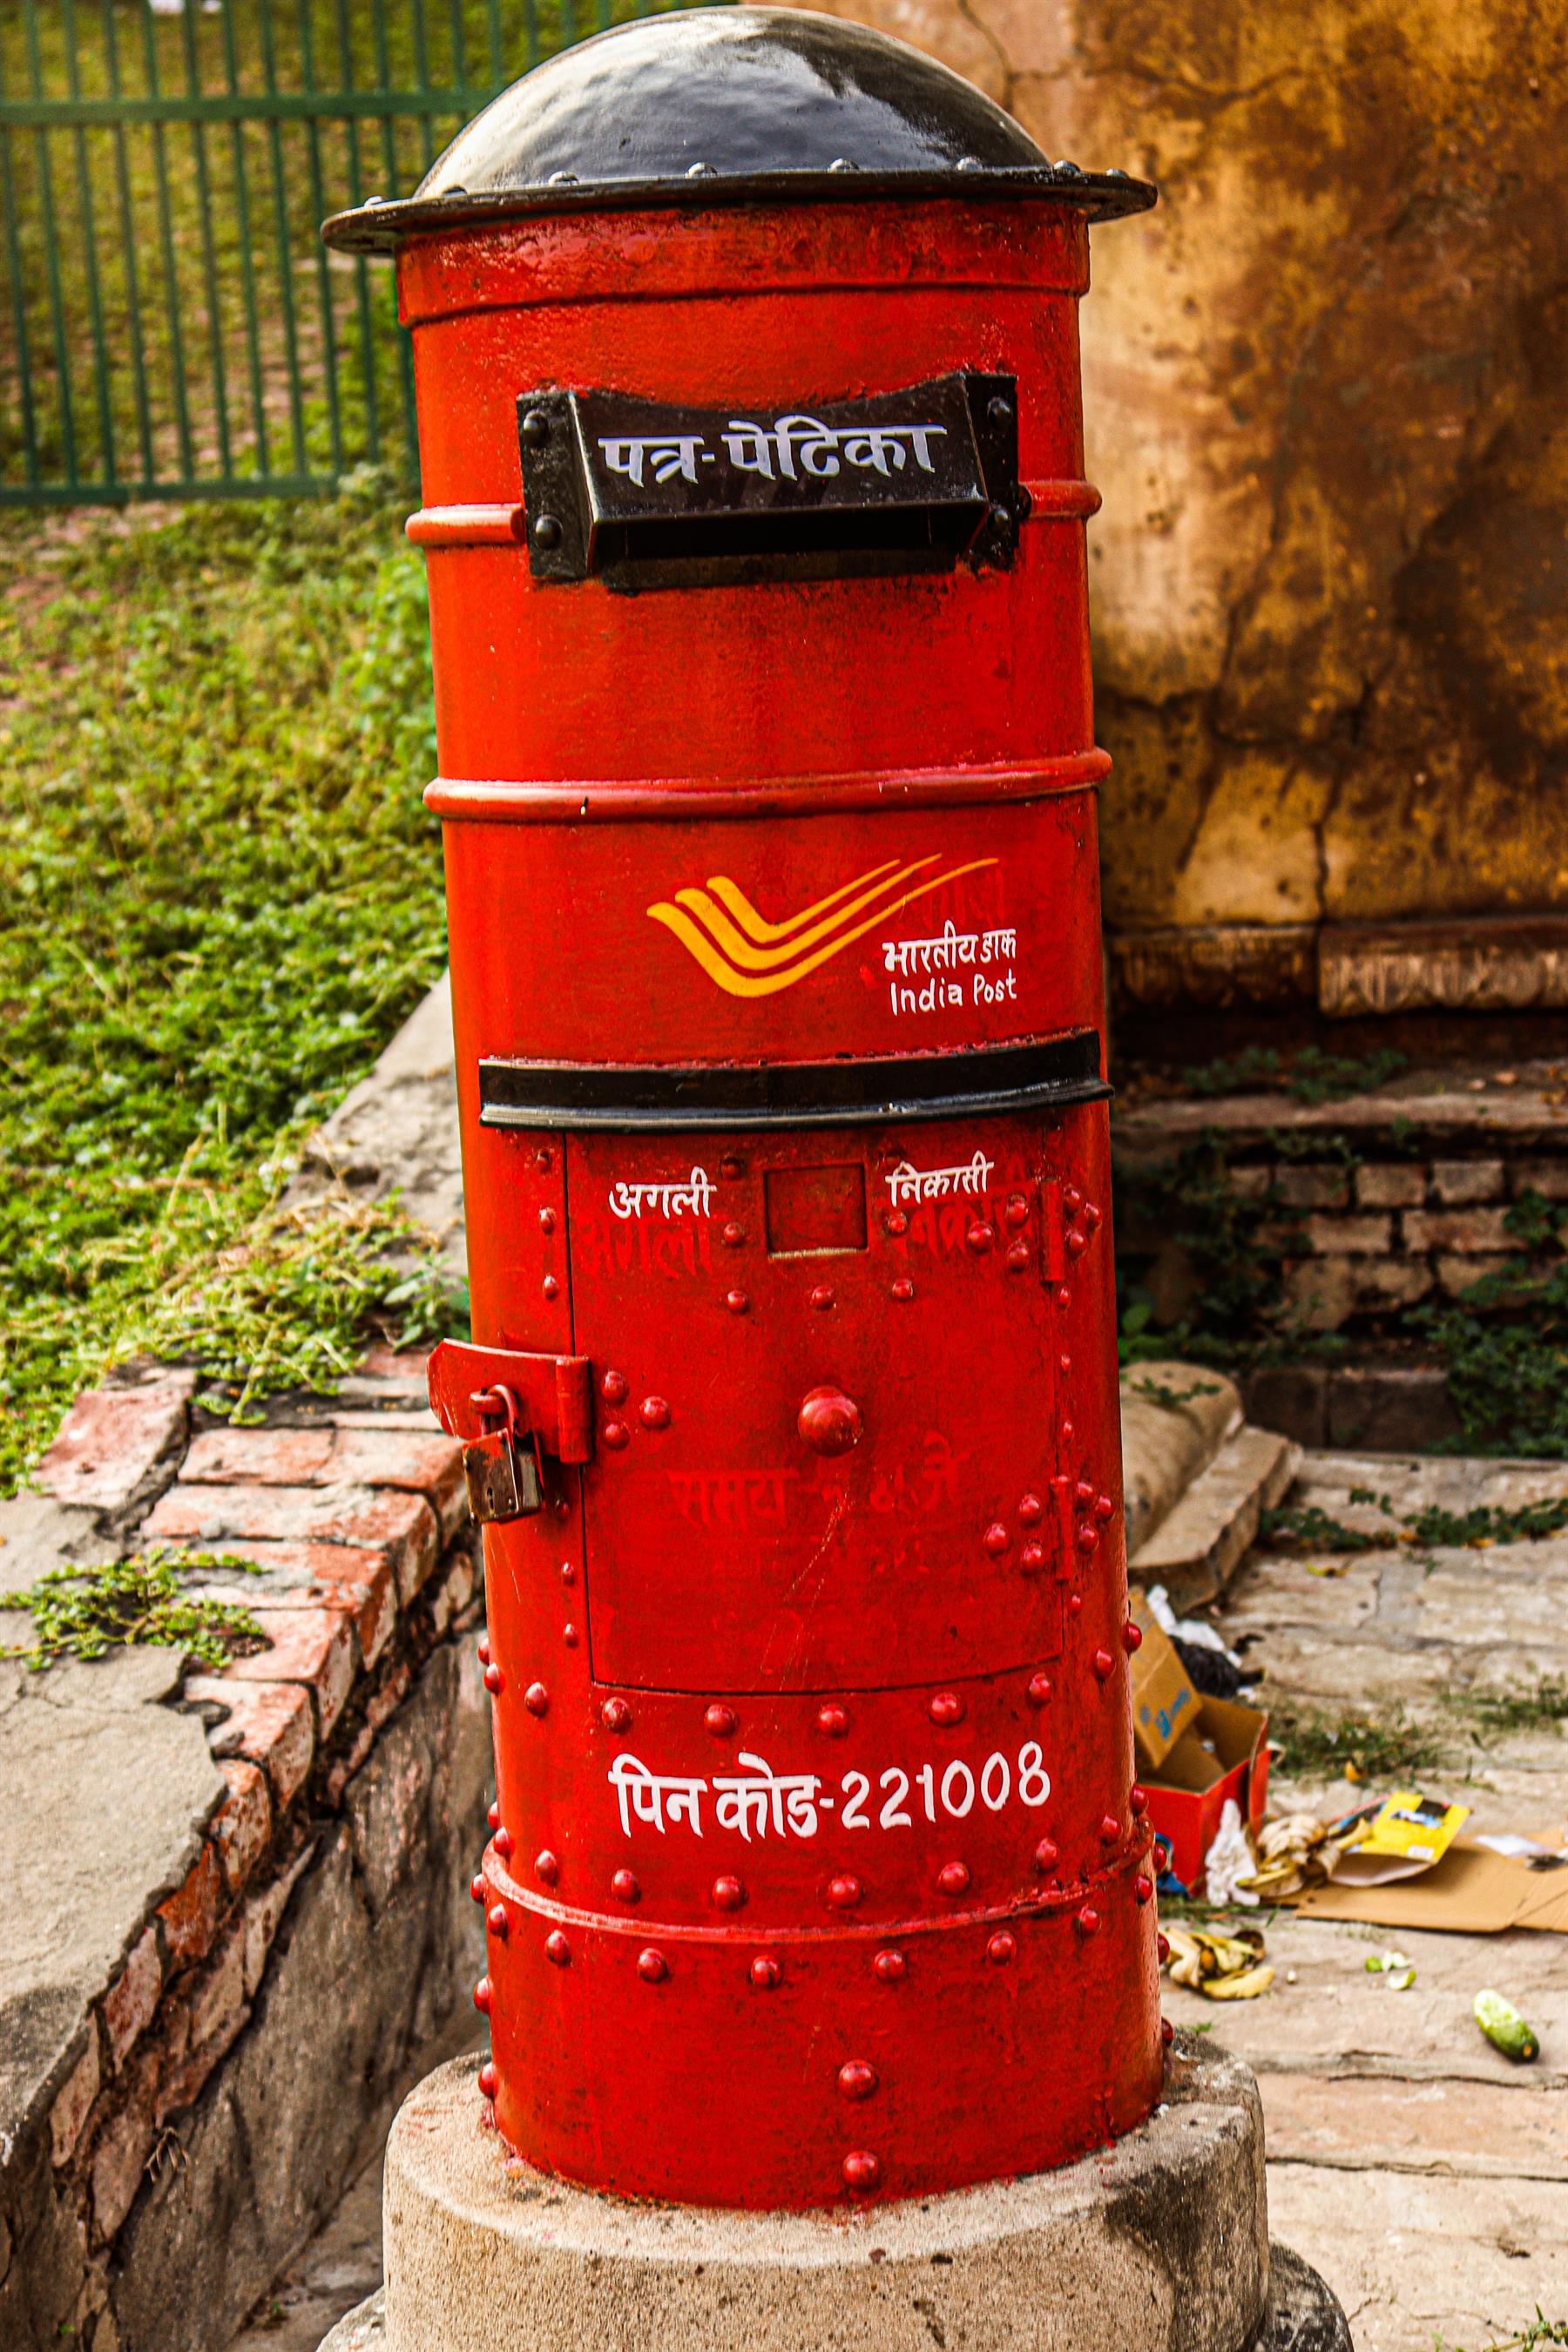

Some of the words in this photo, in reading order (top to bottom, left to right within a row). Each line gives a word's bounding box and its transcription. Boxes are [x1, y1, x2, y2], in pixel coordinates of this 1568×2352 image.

[598, 415, 948, 488] पत्र-पेटिका
[882, 919, 979, 977] भारतीय
[980, 928, 1017, 963] डाक
[890, 977, 963, 1017] India
[973, 968, 1017, 1006] Post
[608, 1166, 718, 1220] अगली
[884, 1150, 995, 1207] निकासी
[607, 1753, 708, 1838] पिन
